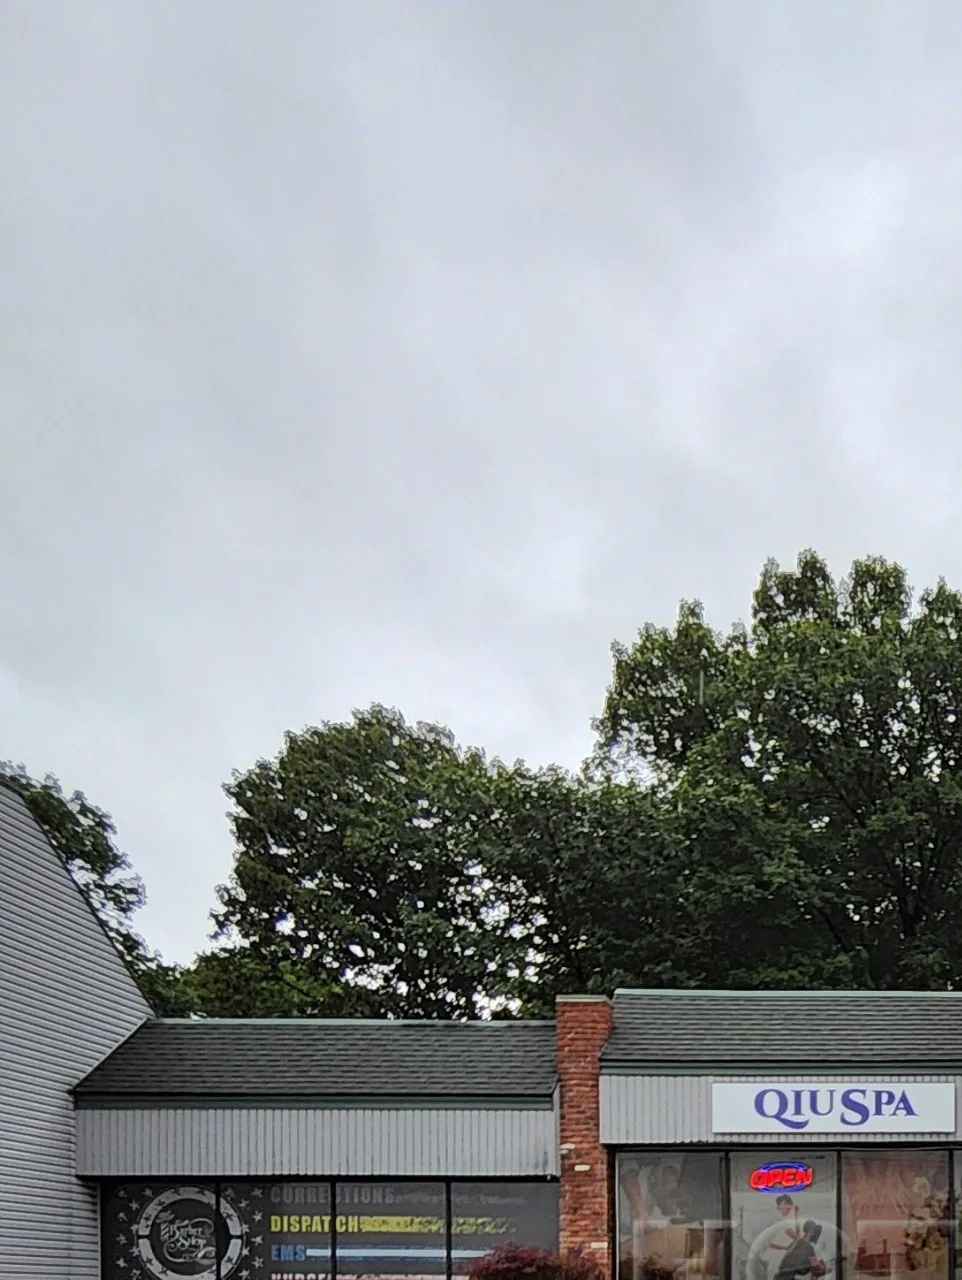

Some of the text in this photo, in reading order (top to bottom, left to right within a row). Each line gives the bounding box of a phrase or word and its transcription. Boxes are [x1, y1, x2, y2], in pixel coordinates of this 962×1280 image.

[750, 1167, 813, 1189] OPEN
[270, 1186, 394, 1204] CORRETIONS
[270, 1215, 359, 1233] DISPATCH
[271, 1244, 305, 1261] EMS
